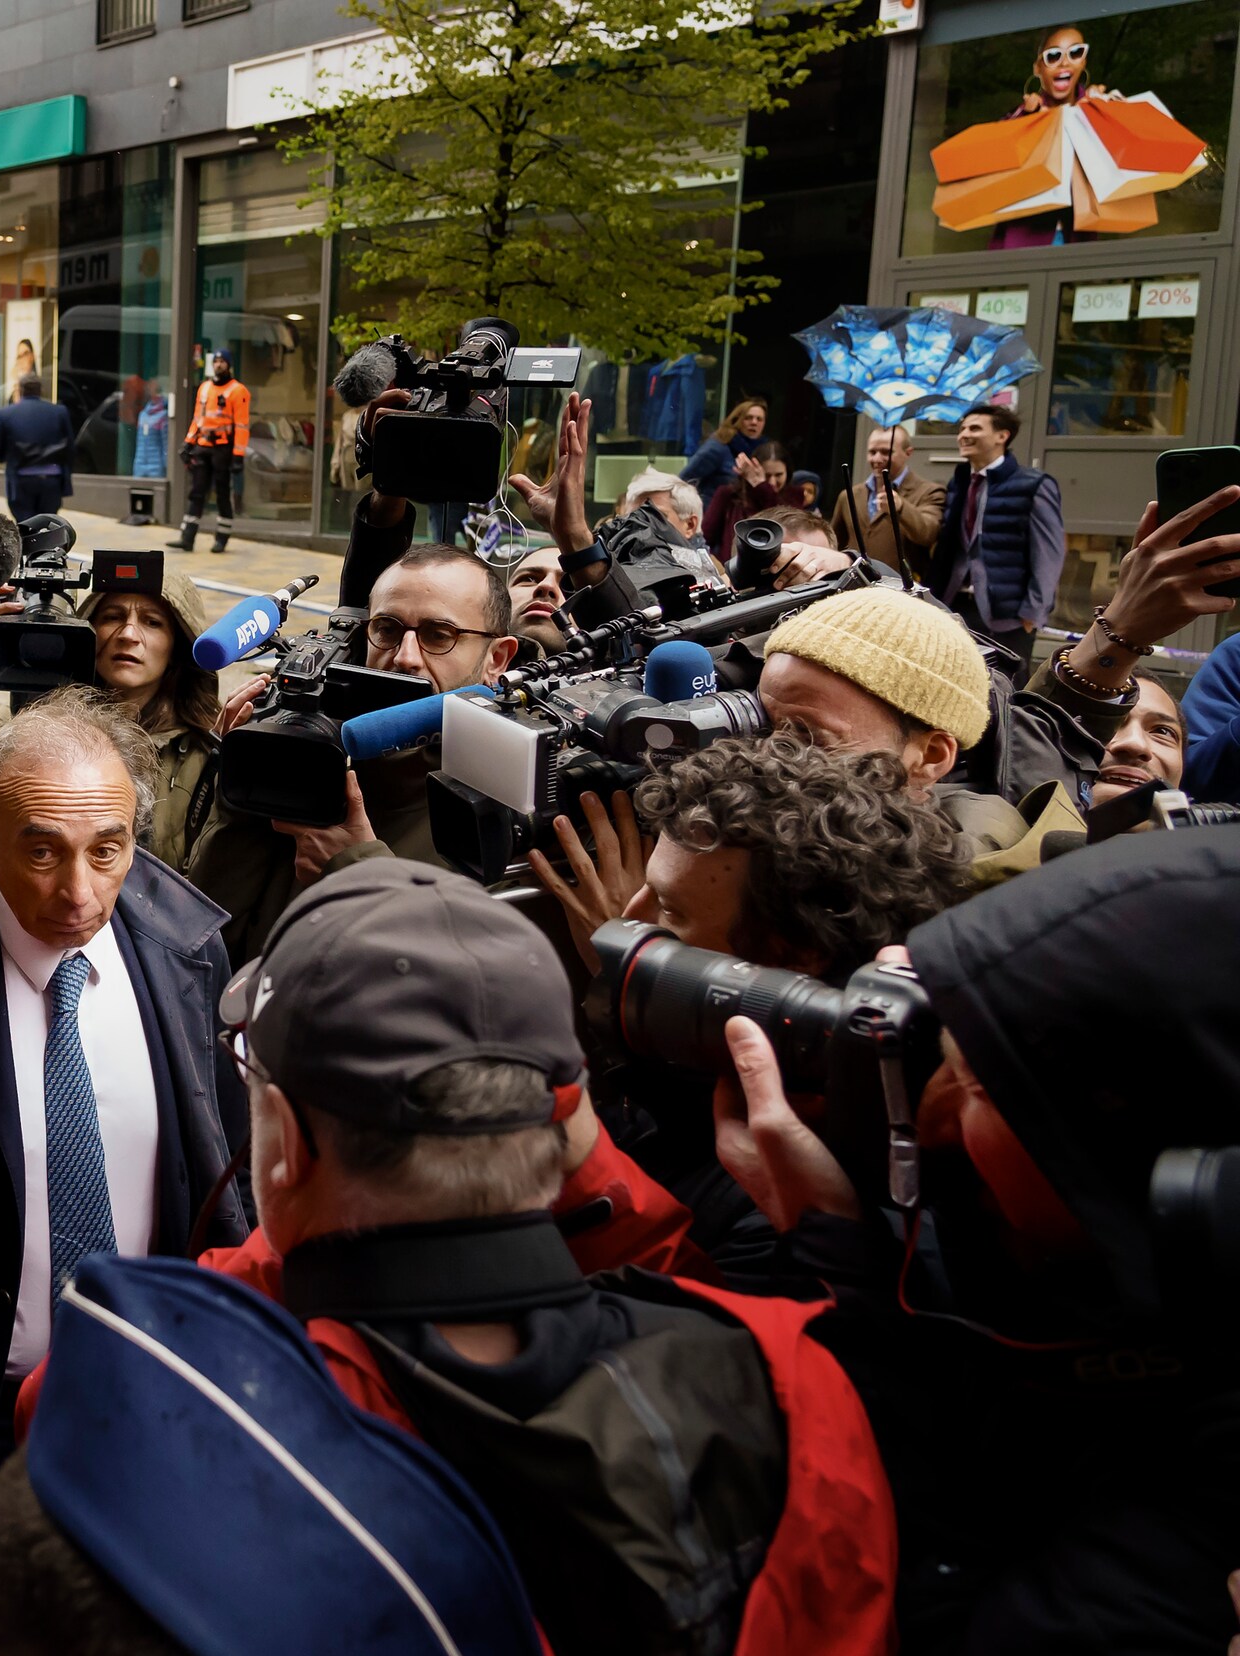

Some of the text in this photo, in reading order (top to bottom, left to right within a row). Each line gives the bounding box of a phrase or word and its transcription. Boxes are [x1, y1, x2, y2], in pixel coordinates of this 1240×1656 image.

[981, 299, 1022, 314] 40%
[1080, 292, 1123, 310] 30%
[1146, 288, 1192, 306] 20%
[235, 619, 258, 650] AFP
[1075, 1346, 1182, 1382] EOS
